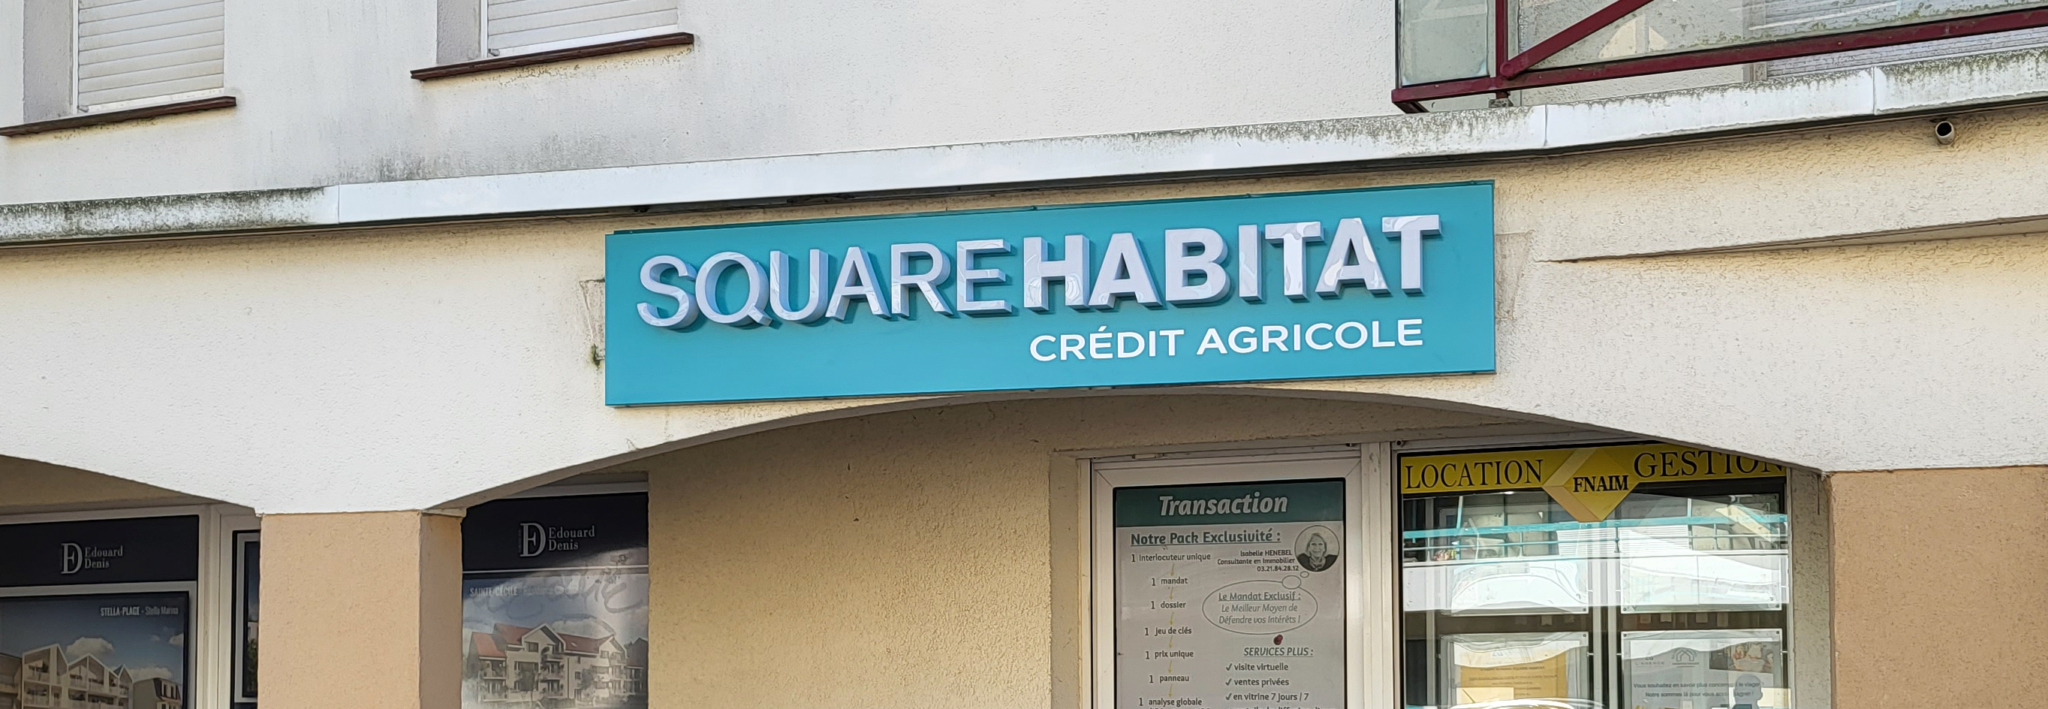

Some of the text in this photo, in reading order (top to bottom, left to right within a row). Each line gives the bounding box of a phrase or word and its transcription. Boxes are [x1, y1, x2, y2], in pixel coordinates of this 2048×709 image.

[636, 214, 1442, 330] SQUARE HABITAT
[1029, 318, 1423, 362] CRÉDIT AGRICOLE
[1405, 459, 1544, 490] LOCATION
[1572, 474, 1629, 493] FNAIM
[1159, 491, 1288, 516] Transaction
[548, 525, 596, 539] Edouard
[1131, 533, 1166, 545] Notre
[1170, 532, 1198, 544] Pack
[1203, 528, 1273, 543] Exclusivité
[548, 539, 579, 551] Denis
[84, 545, 124, 558] Edouard
[1131, 554, 1136, 562] 1
[1186, 553, 1211, 562] unique
[84, 557, 110, 569] Denis
[1151, 576, 1188, 586] 1 mandat
[1229, 592, 1261, 600] Mandat
[1264, 591, 1295, 601] Exclusif
[1151, 600, 1186, 609] 1 dossier
[1221, 603, 1298, 613] Le Meilleur Moyen de
[1218, 615, 1252, 625] Défendre
[1144, 626, 1192, 636] 1 jeu de clés
[1145, 650, 1194, 659] 1 prix unique
[1243, 647, 1285, 656] SERVICES
[1287, 647, 1309, 656] PLUS
[1234, 662, 1289, 671] visite virtuelle
[1149, 675, 1190, 683] 1 panneau
[1261, 678, 1289, 688] privées
[1139, 697, 1202, 707] 1 analyse globale
[1276, 692, 1298, 702] jours
[1303, 692, 1309, 700] 7
